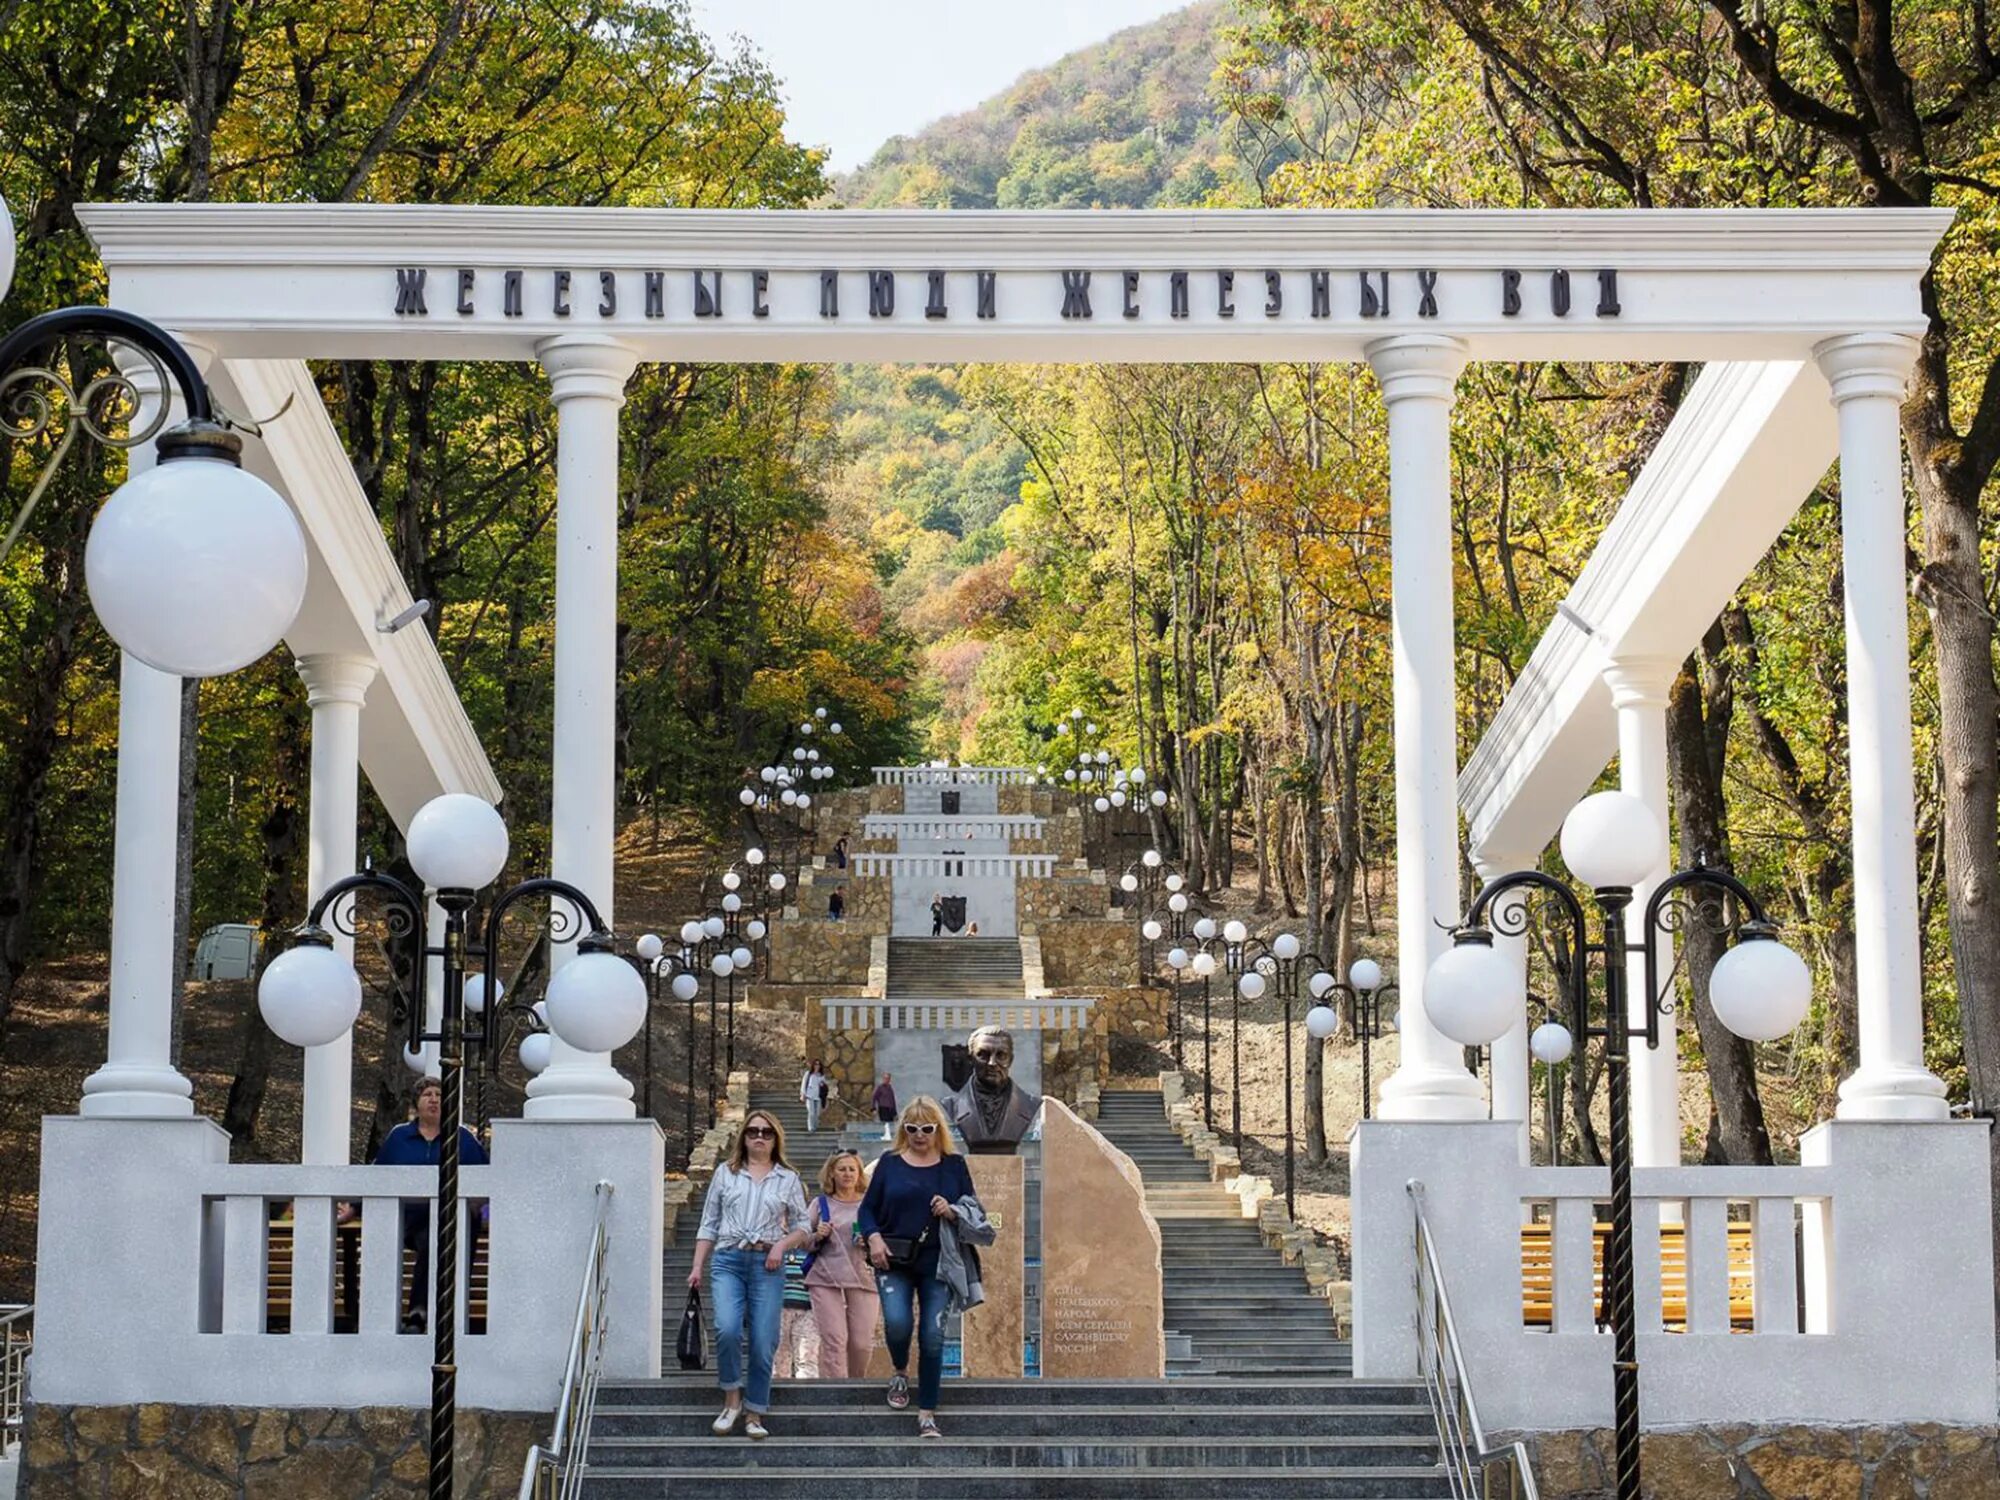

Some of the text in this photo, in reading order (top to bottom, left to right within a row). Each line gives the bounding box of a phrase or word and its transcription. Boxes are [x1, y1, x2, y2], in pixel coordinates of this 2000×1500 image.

[394, 269, 1622, 317] ЖЕЛЕЗНЫЕ ЛЮДИ ЖЕЛЕЗНЫХ ВОД
